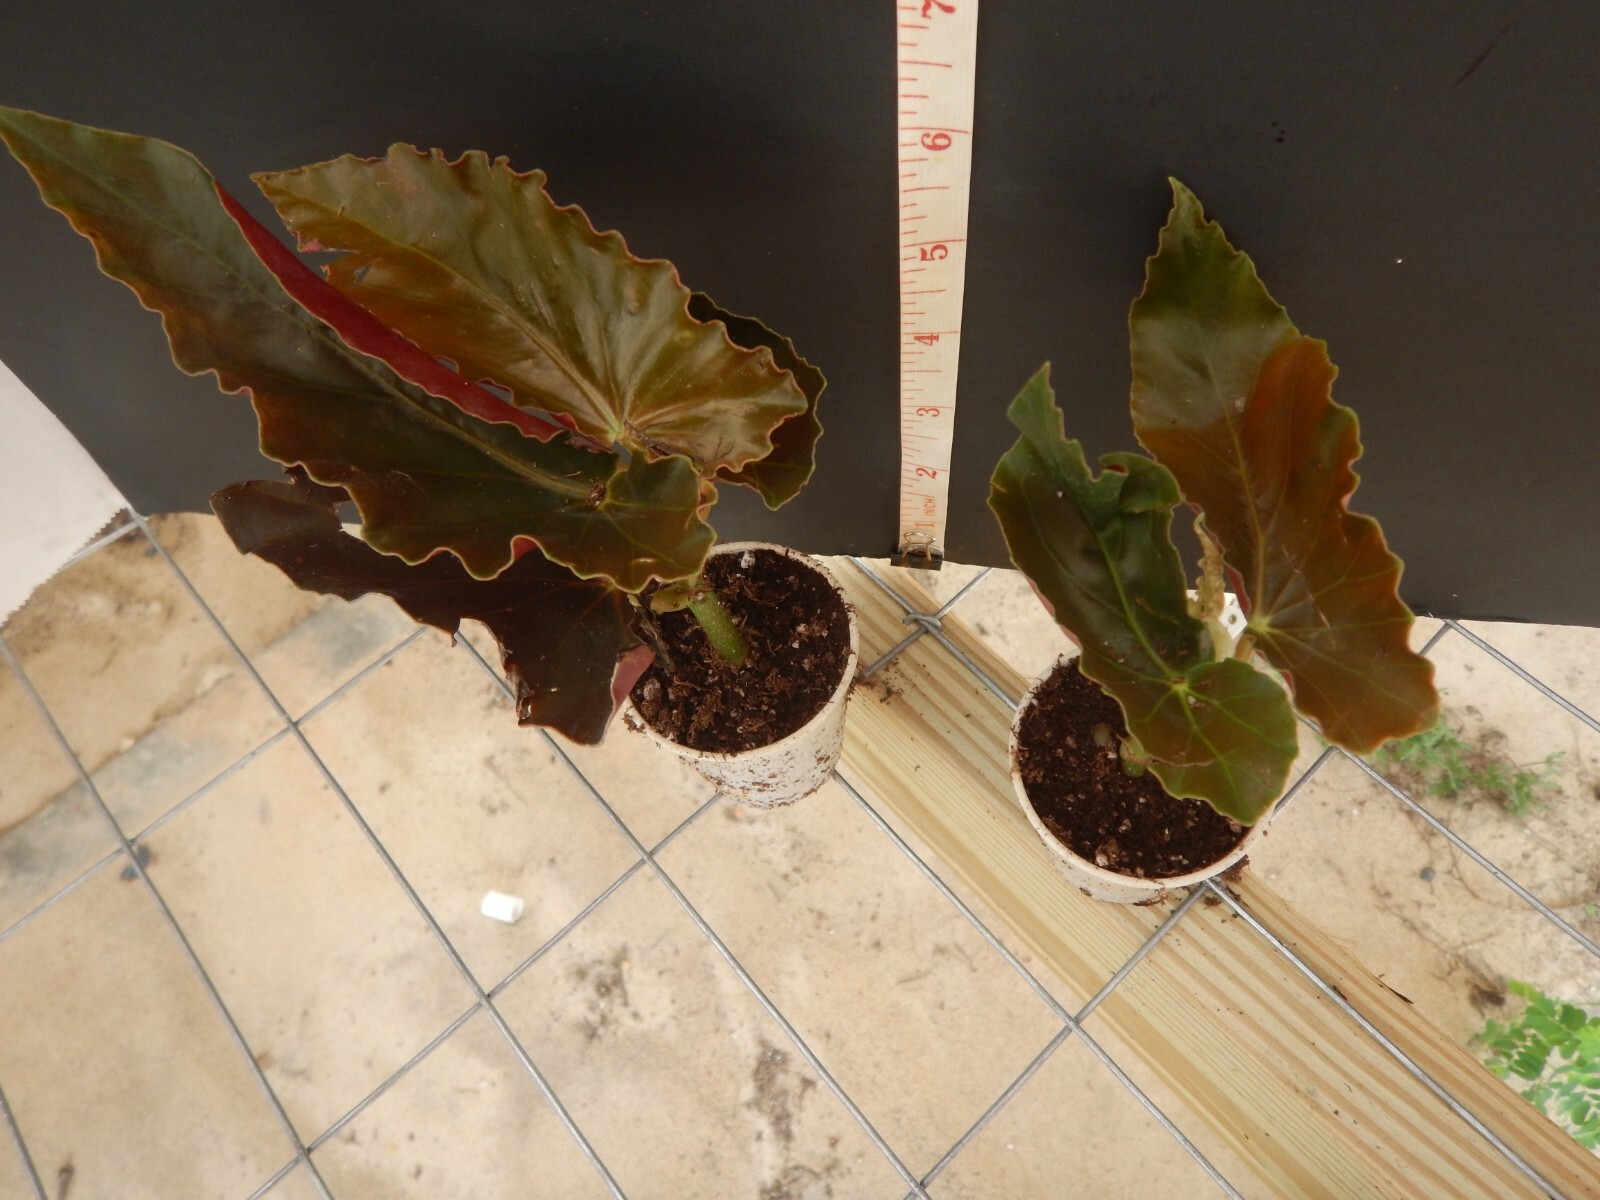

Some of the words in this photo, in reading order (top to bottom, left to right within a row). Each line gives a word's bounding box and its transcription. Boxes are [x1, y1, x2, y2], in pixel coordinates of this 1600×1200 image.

[921, 0, 956, 19] 7
[921, 133, 952, 151] 6
[920, 244, 948, 261] 5
[914, 334, 940, 346] 4
[916, 407, 940, 417] 3
[915, 467, 937, 480] 2
[923, 497, 936, 517] INCH
